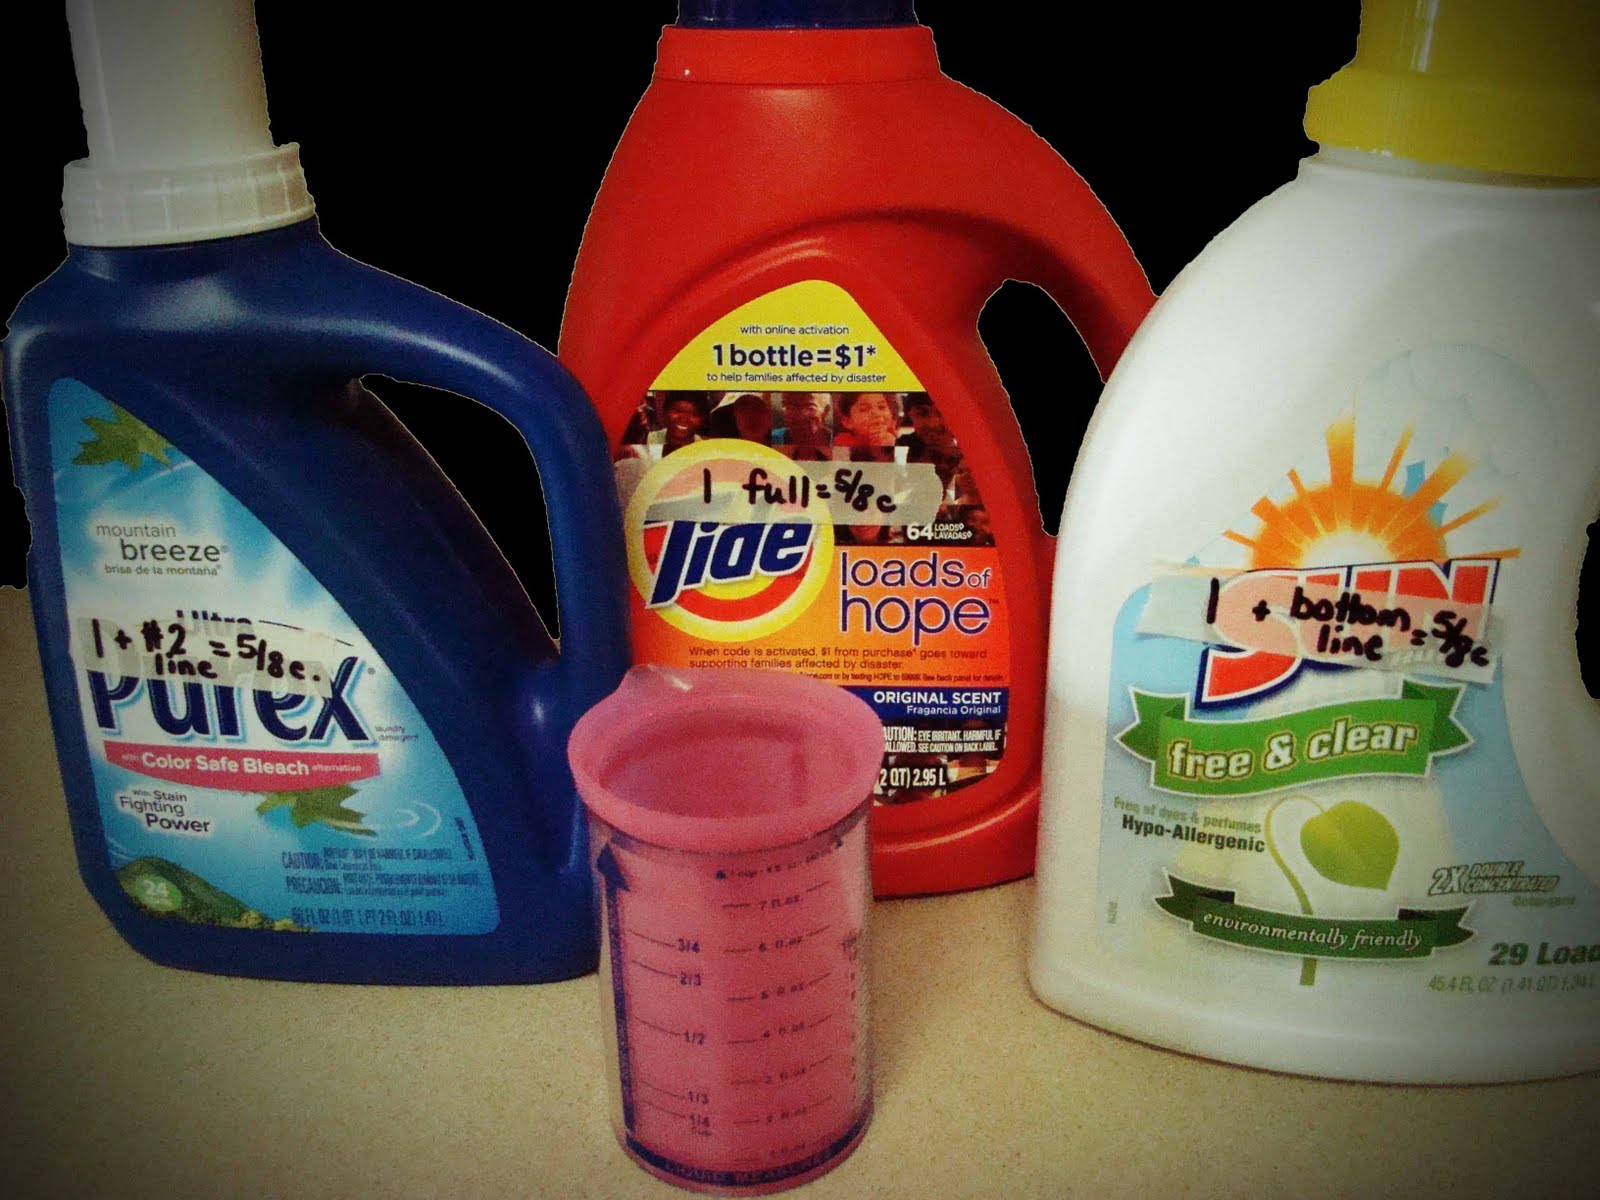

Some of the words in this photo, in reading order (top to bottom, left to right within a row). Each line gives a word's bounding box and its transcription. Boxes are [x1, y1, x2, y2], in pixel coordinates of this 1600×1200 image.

[740, 324, 762, 335] with
[765, 324, 796, 335] online
[798, 324, 850, 335] activation
[707, 373, 718, 382] to
[720, 372, 743, 383] help
[745, 372, 783, 382] families
[786, 373, 828, 383] affected
[831, 373, 844, 384] by
[846, 373, 887, 383] disaster
[96, 523, 176, 539] mountain
[906, 523, 934, 540] 64
[934, 523, 960, 531] LOADS
[934, 531, 968, 540] LAVADAS
[120, 539, 222, 563] breeze
[104, 564, 133, 575] brisa
[135, 565, 150, 575] de
[152, 565, 163, 575] la
[840, 550, 965, 589] loads
[966, 568, 991, 589] of
[840, 588, 991, 647] hope
[1290, 586, 1411, 632] bottom
[689, 646, 720, 657] When
[723, 646, 750, 657] code
[754, 647, 763, 657] is
[766, 646, 818, 658] activated,
[821, 646, 831, 658] $1
[834, 646, 859, 657] from
[920, 650, 946, 661] goes
[949, 648, 987, 659] toward
[689, 659, 748, 669] supporting
[750, 658, 792, 668] families
[795, 658, 840, 669] affected
[843, 659, 857, 671] by
[87, 656, 373, 744] Purex
[873, 691, 948, 704] ORIGINAL
[952, 691, 1002, 704] SCENT
[906, 705, 958, 716] Fragancia
[960, 705, 1001, 716] Original
[883, 726, 918, 742] AUTION:
[918, 730, 931, 741] EYE
[963, 730, 993, 741] HARMFUL
[994, 729, 1001, 740] IF
[884, 742, 917, 752] ALLOWED.
[918, 743, 929, 752] SEE
[930, 743, 954, 752] CAUTION
[955, 743, 963, 752] ON
[964, 742, 978, 752] BACK
[1168, 740, 1253, 780] free
[1264, 732, 1295, 771] &
[1307, 719, 1417, 761] clear
[142, 752, 191, 769] Color
[195, 755, 239, 773] Safe
[243, 757, 311, 777] Bleach
[890, 768, 910, 788] QT)
[912, 768, 936, 787] 2.95
[938, 768, 946, 787] L
[154, 789, 187, 802] Stain
[119, 796, 185, 817] Fighting
[145, 812, 211, 833] Power
[1121, 814, 1265, 853] Hypo-Allergenic
[143, 880, 169, 897] 24
[1427, 865, 1468, 896] 2X
[1203, 911, 1348, 950] environmentally
[1350, 928, 1422, 951] friendly
[678, 937, 700, 953] 3/4
[1488, 941, 1530, 966] 29
[689, 1114, 710, 1128] 1/4
